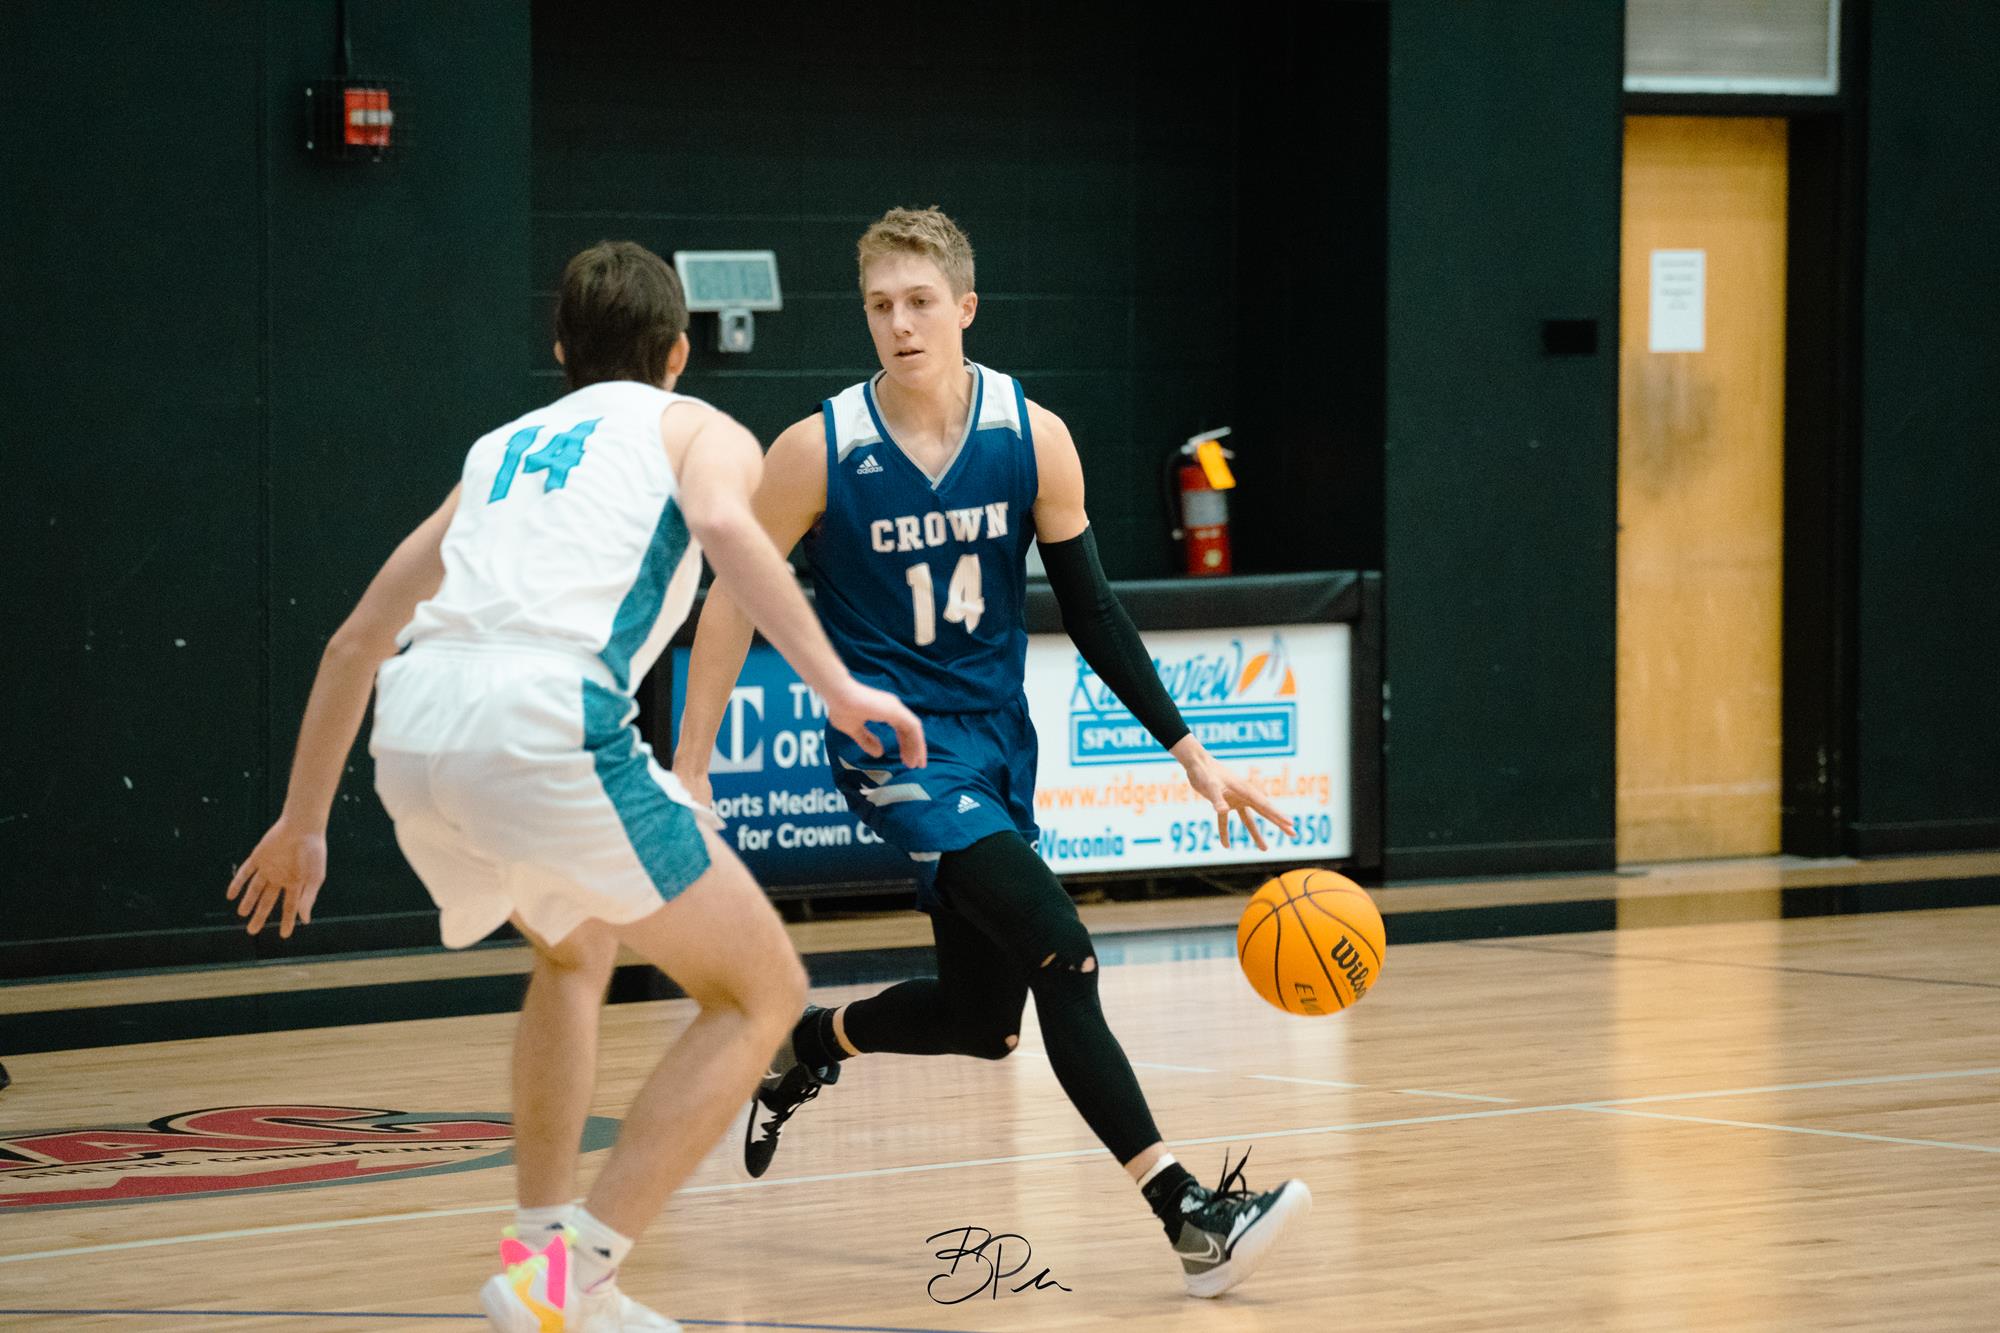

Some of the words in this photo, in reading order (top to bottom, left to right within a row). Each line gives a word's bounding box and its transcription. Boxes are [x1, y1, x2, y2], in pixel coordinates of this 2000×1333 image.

[487, 416, 604, 504] 14
[870, 502, 1009, 553] CROWN
[906, 553, 986, 646] 14
[1082, 726, 1154, 750] SPORT
[711, 793, 764, 819] orts
[738, 824, 773, 850] for
[777, 822, 852, 849] Crown
[9, 1159, 201, 1180] ATHLETIC
[207, 1144, 488, 1163] CONFERENCE
